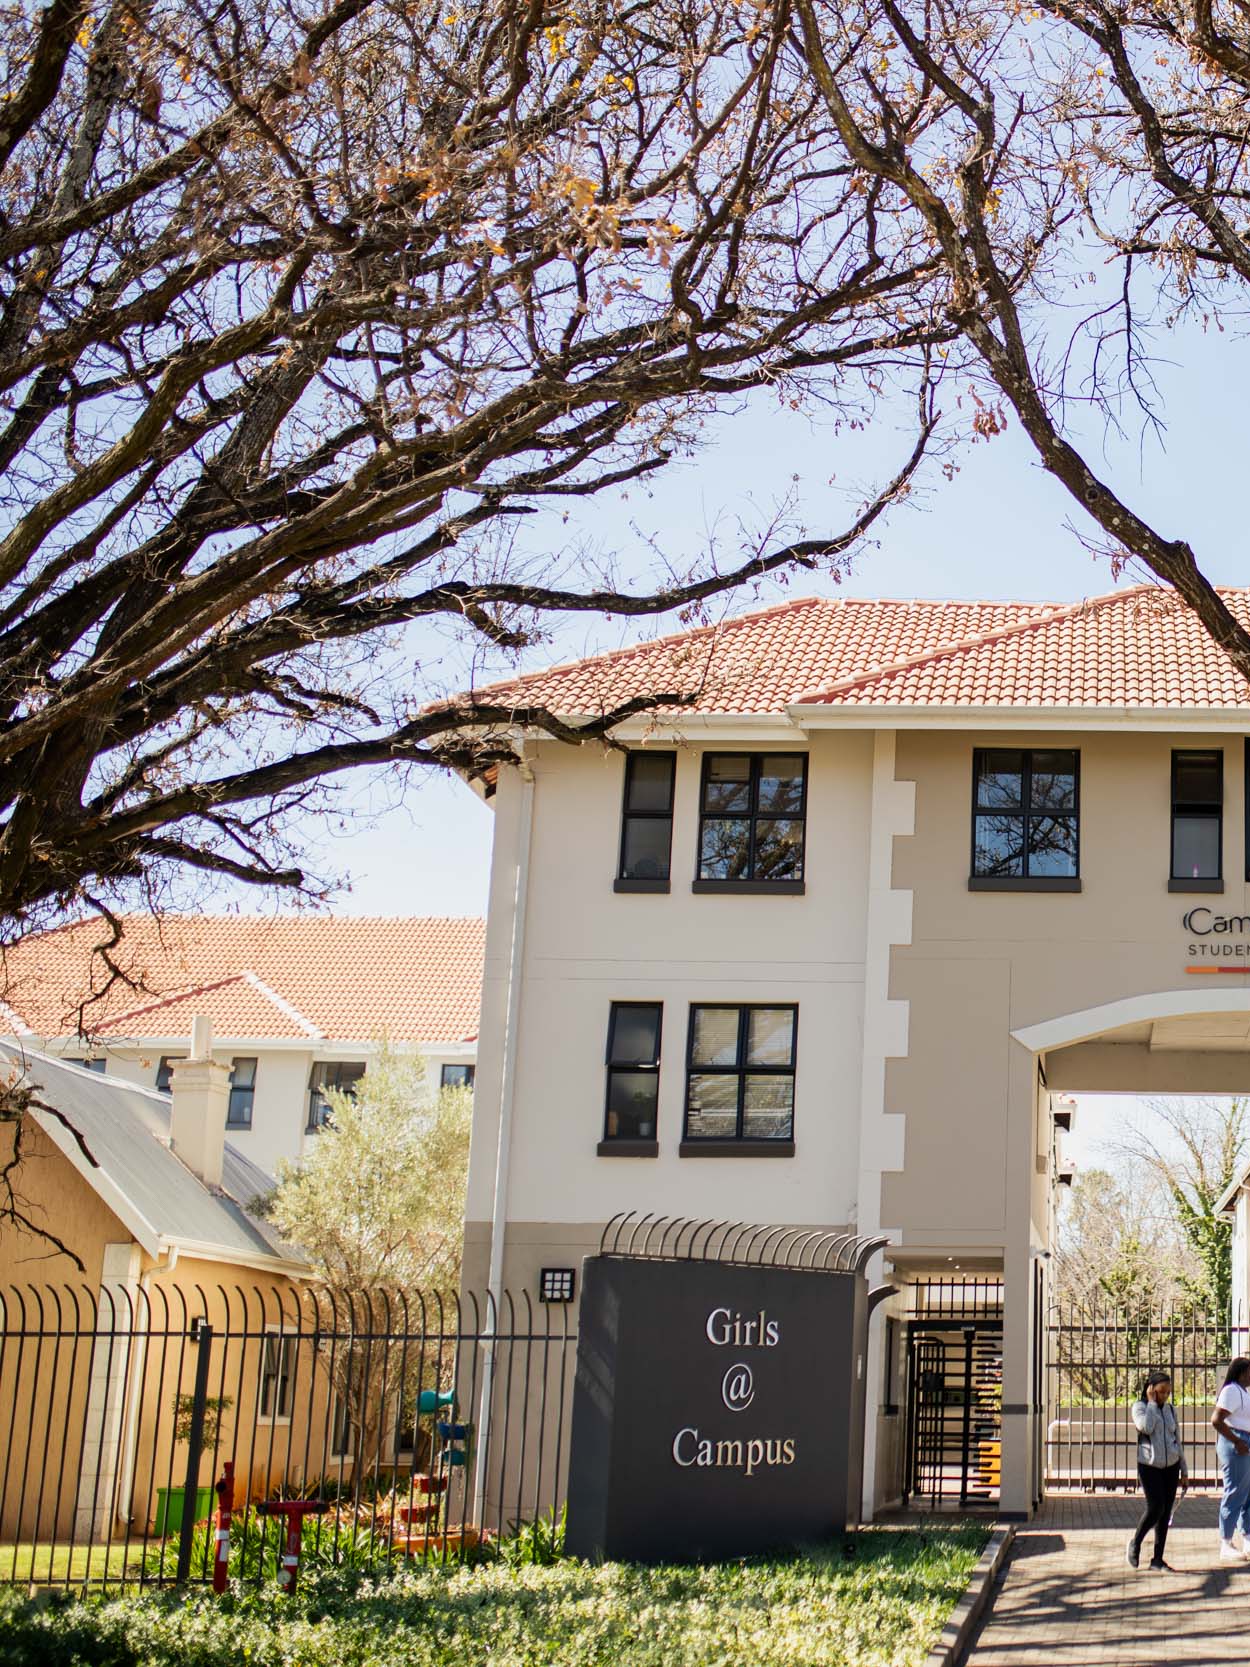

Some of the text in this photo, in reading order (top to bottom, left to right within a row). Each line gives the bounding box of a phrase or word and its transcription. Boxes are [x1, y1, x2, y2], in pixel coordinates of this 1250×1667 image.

[706, 1308, 779, 1346] Girls
[722, 1363, 755, 1411] @
[672, 1428, 796, 1476] Campus
